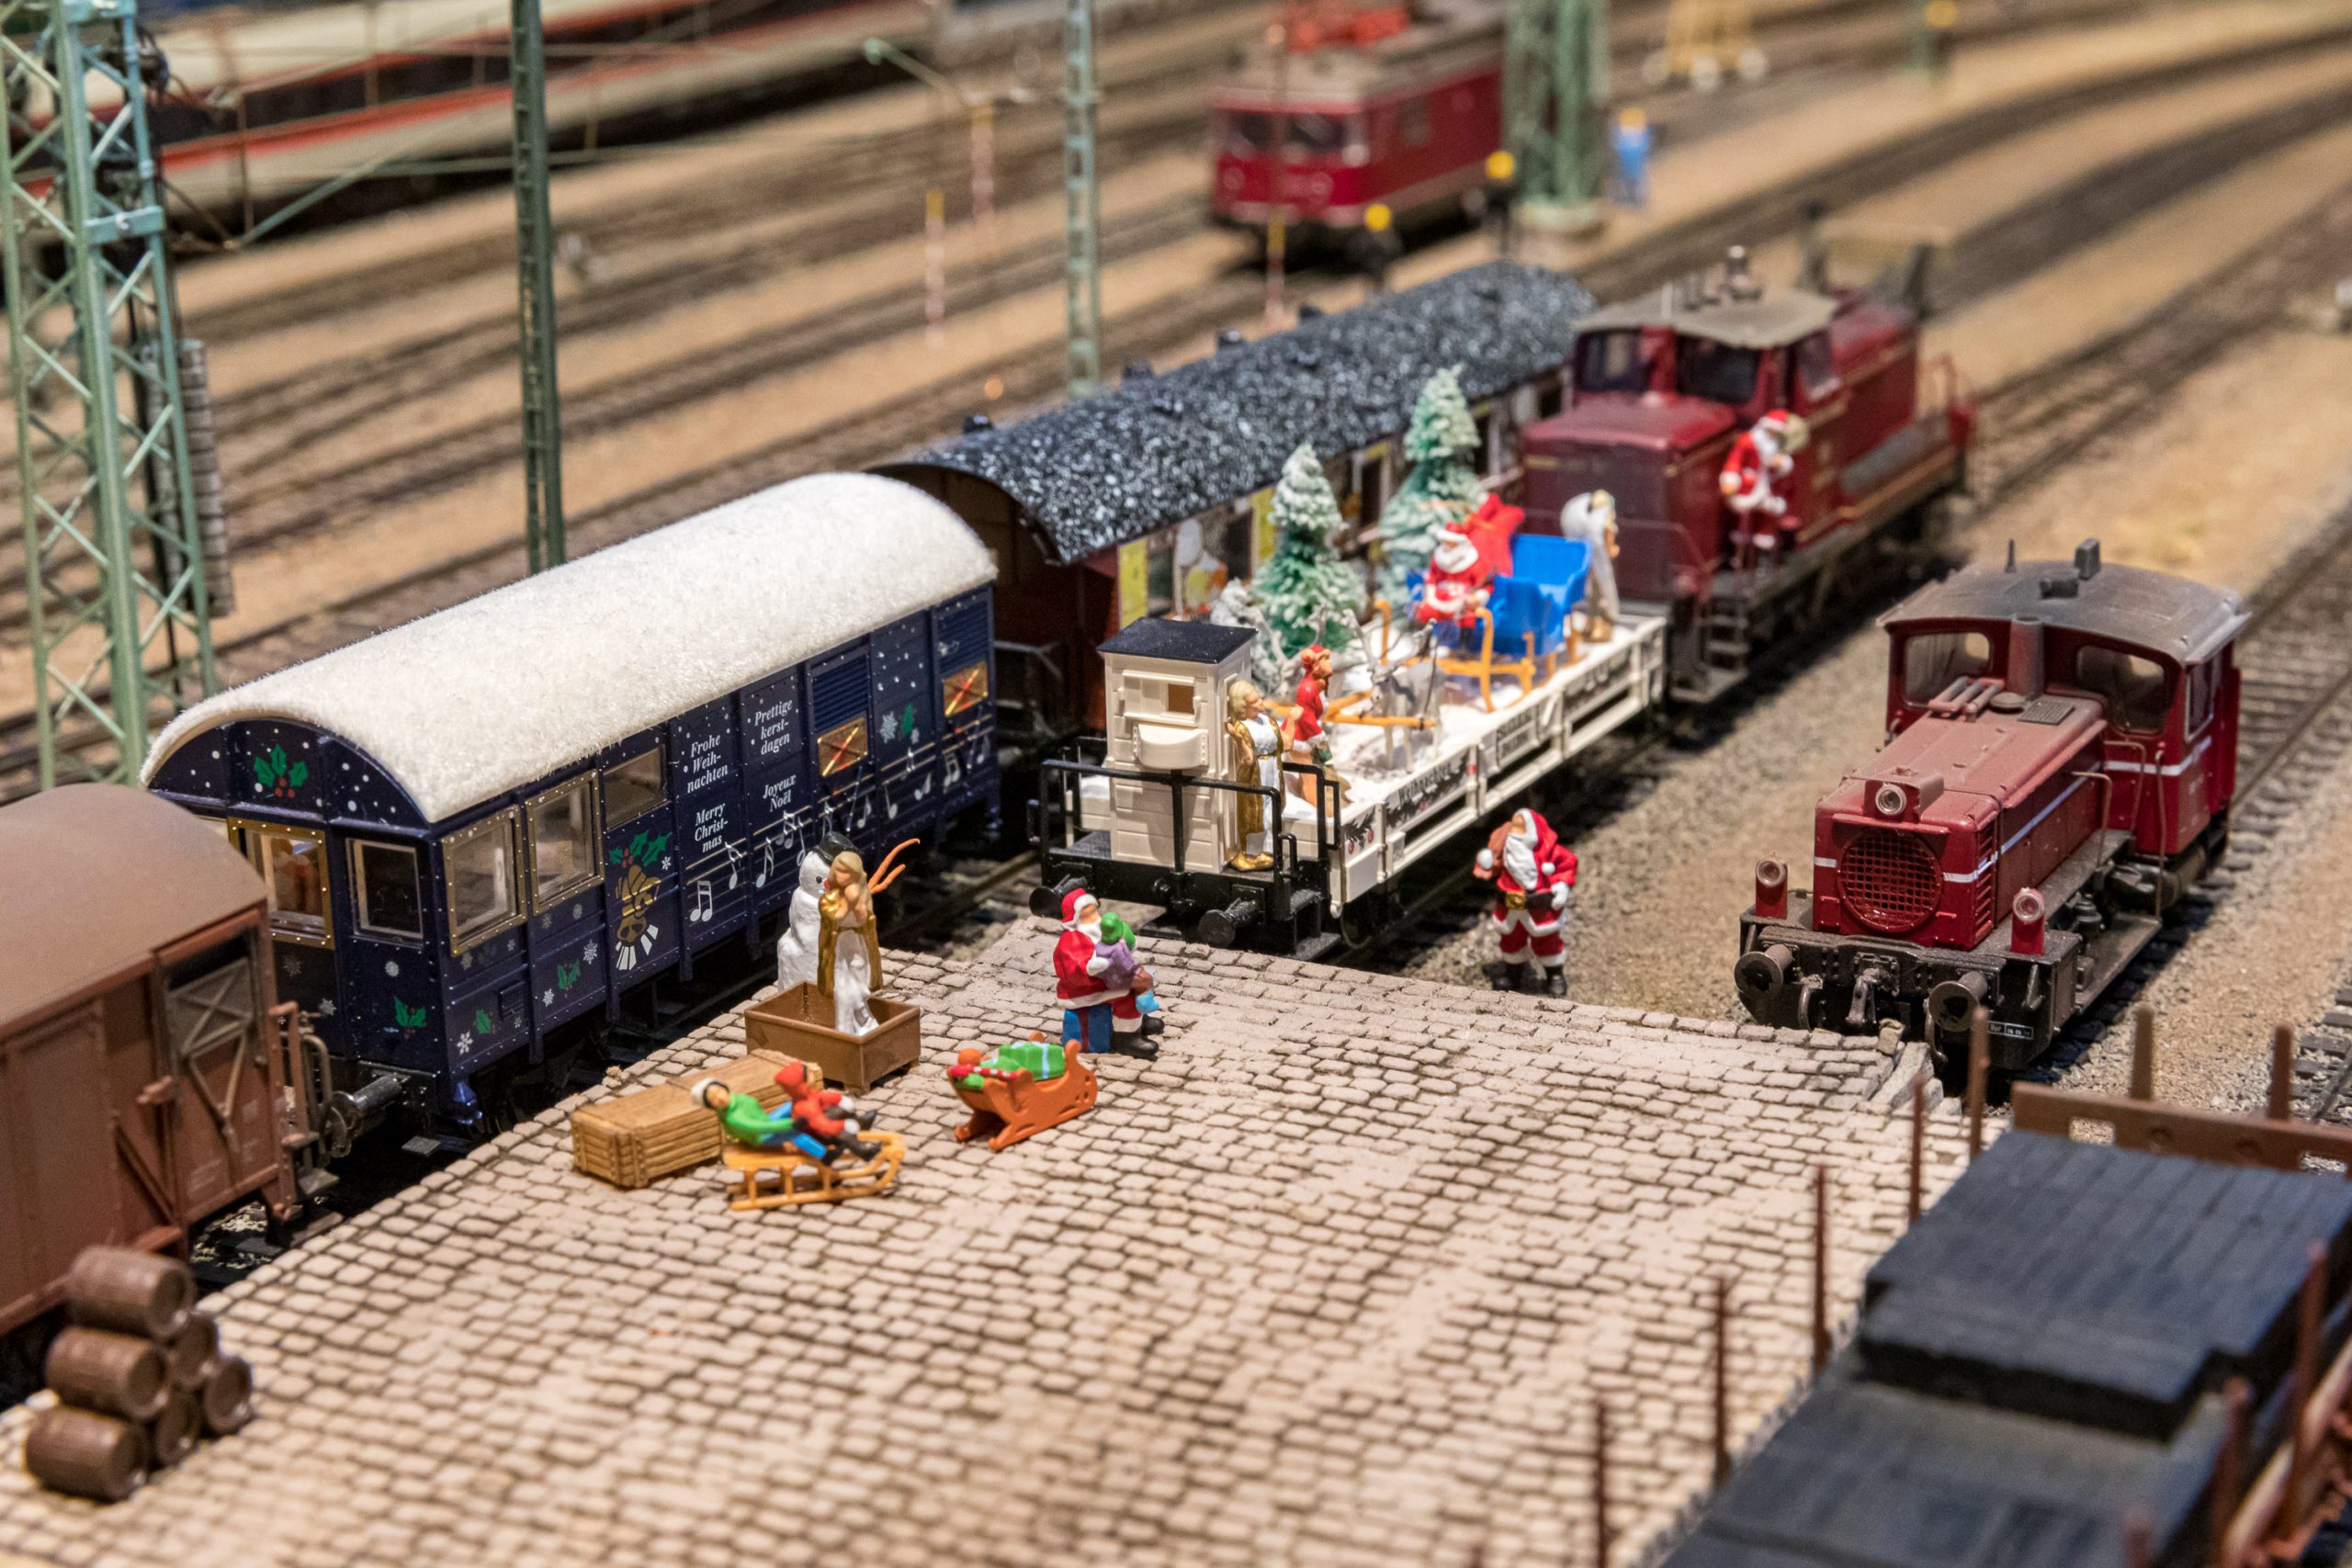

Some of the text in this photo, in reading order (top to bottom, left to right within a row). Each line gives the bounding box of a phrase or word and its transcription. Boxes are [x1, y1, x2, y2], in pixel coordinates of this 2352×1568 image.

[754, 700, 792, 726] Prettige
[761, 718, 788, 739] kerst-
[691, 735, 720, 757] Frohe
[761, 734, 789, 754] dagen
[693, 751, 721, 773] Weih-
[687, 765, 728, 793] nachten
[763, 774, 797, 798] Joyeux
[770, 790, 791, 812] Noël
[695, 803, 726, 826] Merry
[695, 818, 729, 841] Christ-
[703, 835, 722, 852] mas
